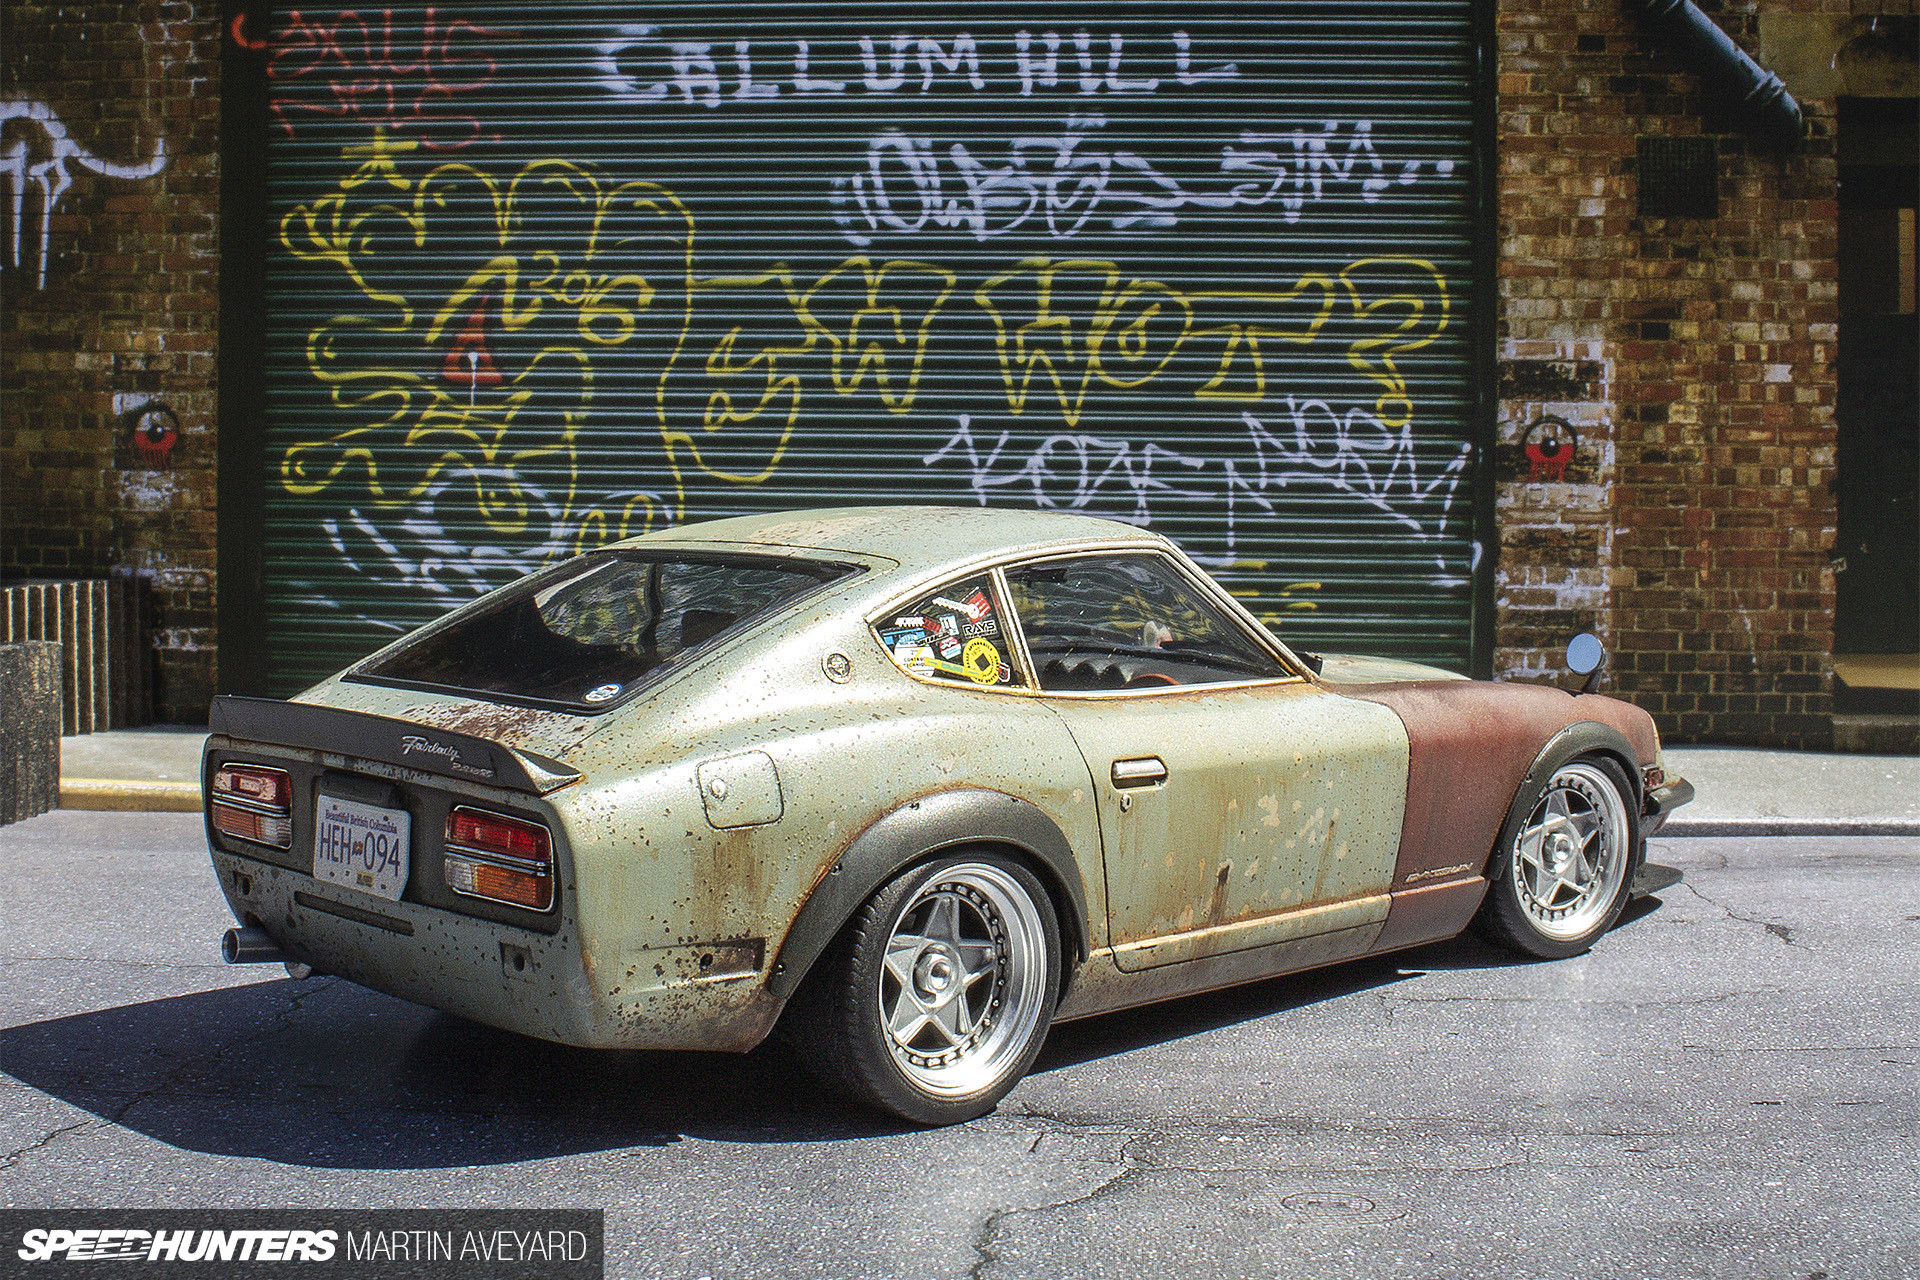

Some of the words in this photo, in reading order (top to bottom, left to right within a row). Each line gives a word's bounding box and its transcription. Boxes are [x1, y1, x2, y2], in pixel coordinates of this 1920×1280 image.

[597, 24, 986, 108] CALLUM
[1014, 29, 1240, 98] HILL
[963, 620, 996, 635] RAYS
[402, 735, 461, 761] Fairlady
[320, 821, 352, 865] HEH
[363, 830, 401, 878] 094
